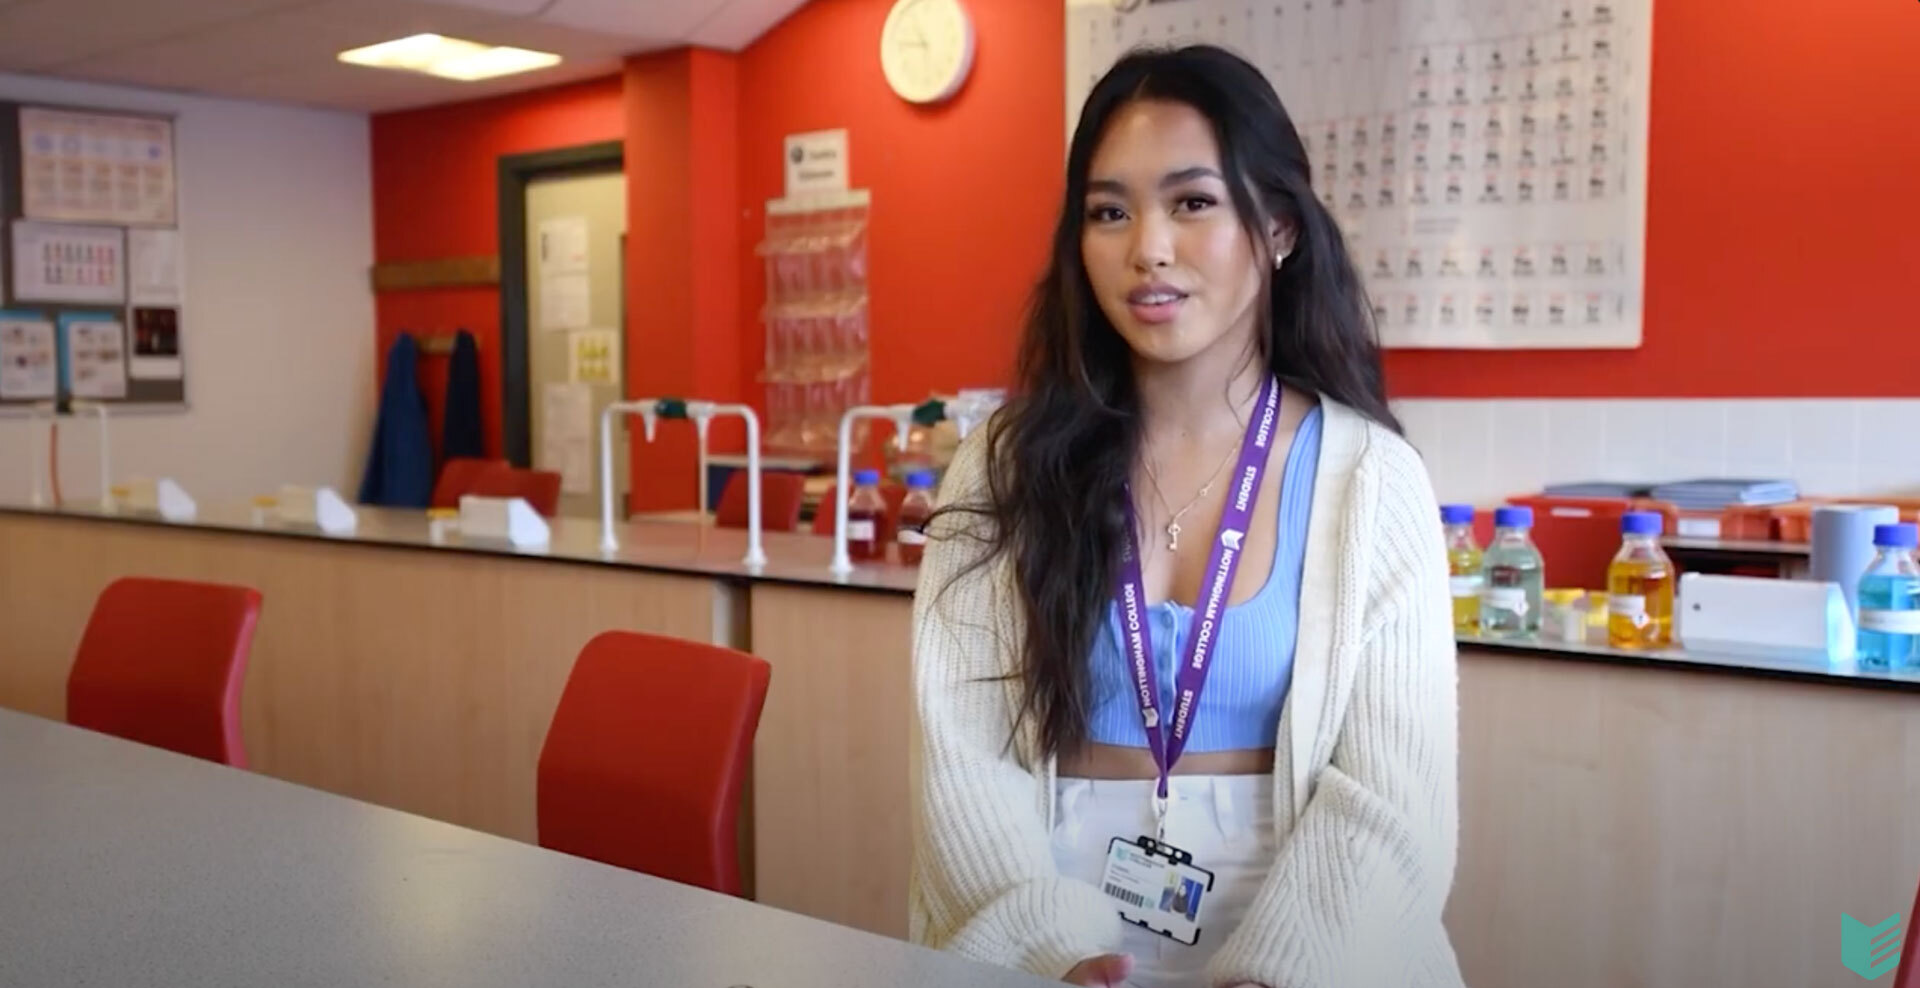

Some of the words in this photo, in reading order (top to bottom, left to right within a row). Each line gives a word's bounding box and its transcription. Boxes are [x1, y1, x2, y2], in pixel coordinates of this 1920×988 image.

[1254, 407, 1275, 447] COLLEGE
[1235, 465, 1257, 512] STUDENT
[1123, 583, 1141, 631] COLLEGE
[1204, 548, 1234, 620] NOTTINGHAM
[1131, 630, 1152, 707] NOTTINGHAM
[1192, 619, 1214, 669] COLLEGE
[1174, 689, 1194, 739] STUDENT
